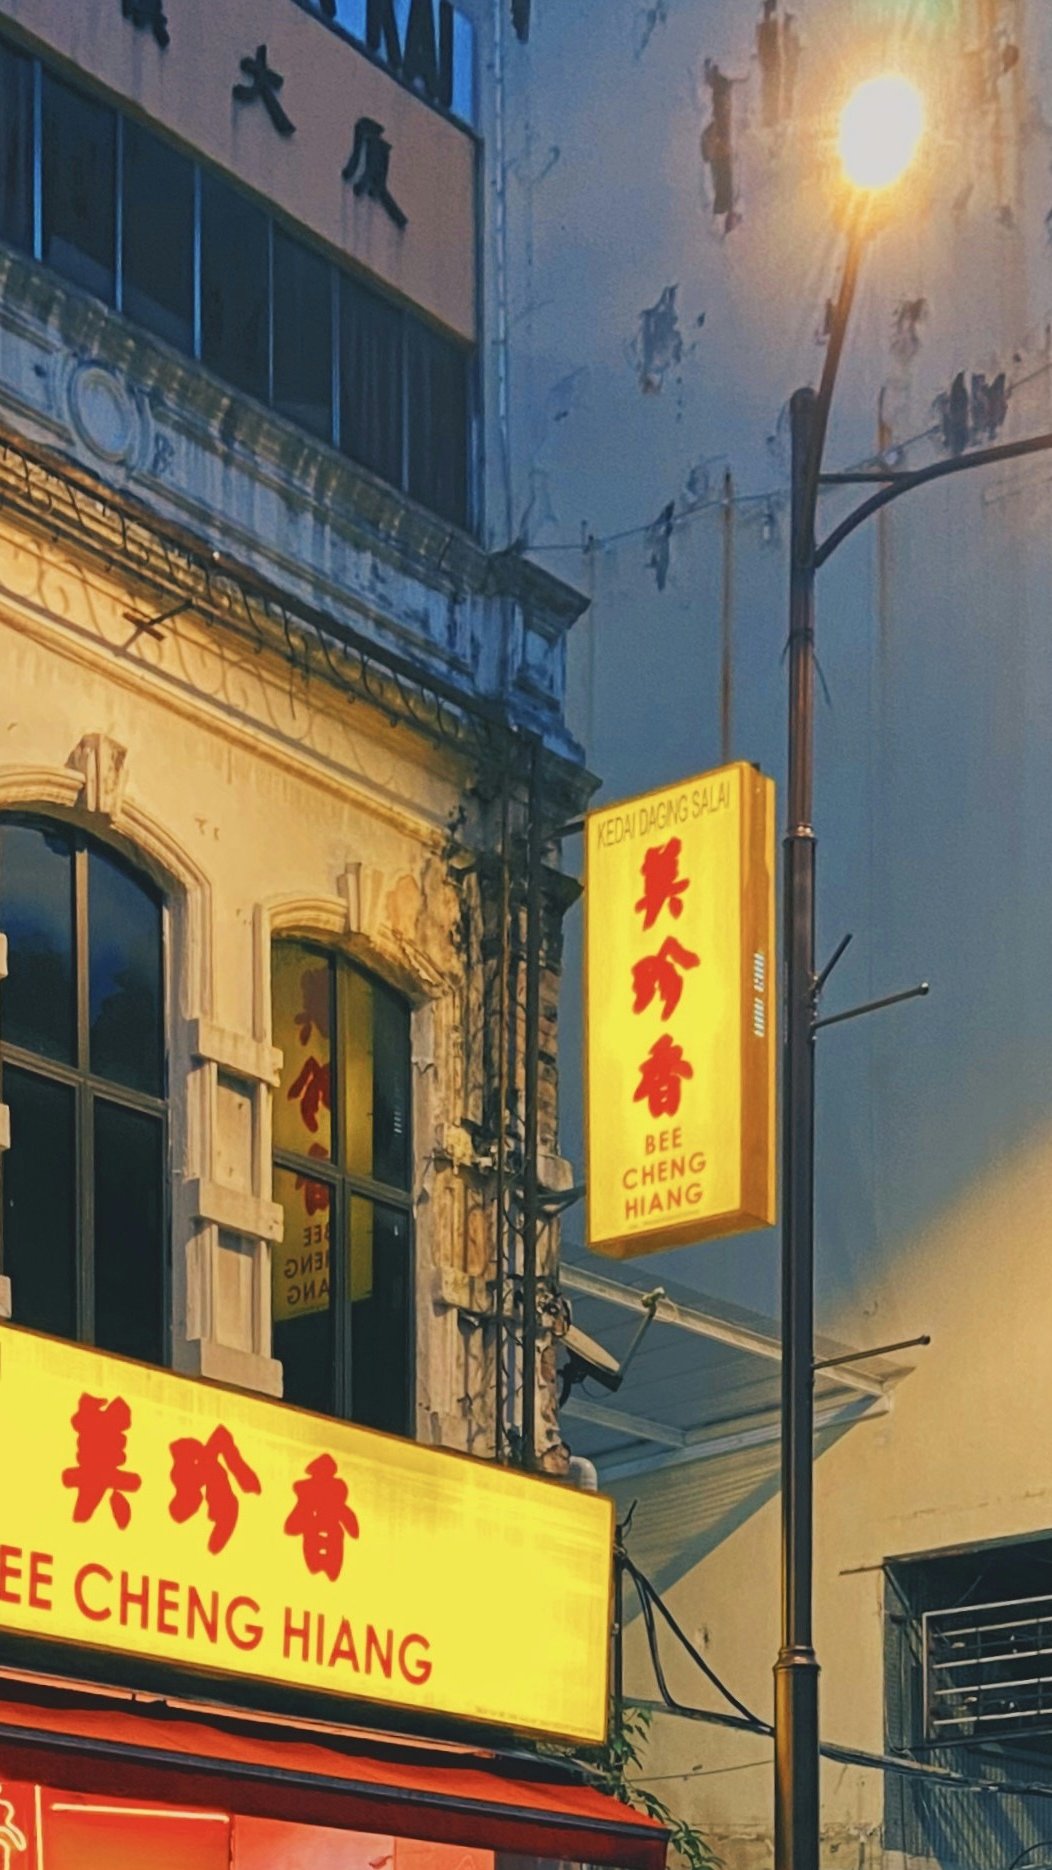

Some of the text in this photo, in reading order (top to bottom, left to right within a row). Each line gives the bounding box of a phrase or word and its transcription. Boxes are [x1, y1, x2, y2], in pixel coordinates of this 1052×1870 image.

[597, 780, 730, 850] KEDAI DAGING SALAI
[645, 1126, 682, 1156] BEE
[622, 1151, 706, 1190] CHENG
[625, 1182, 703, 1220] HIANG
[61, 1392, 360, 1582] 美珍香
[74, 1563, 264, 1651] CHENG
[282, 1606, 433, 1685] HIANG
